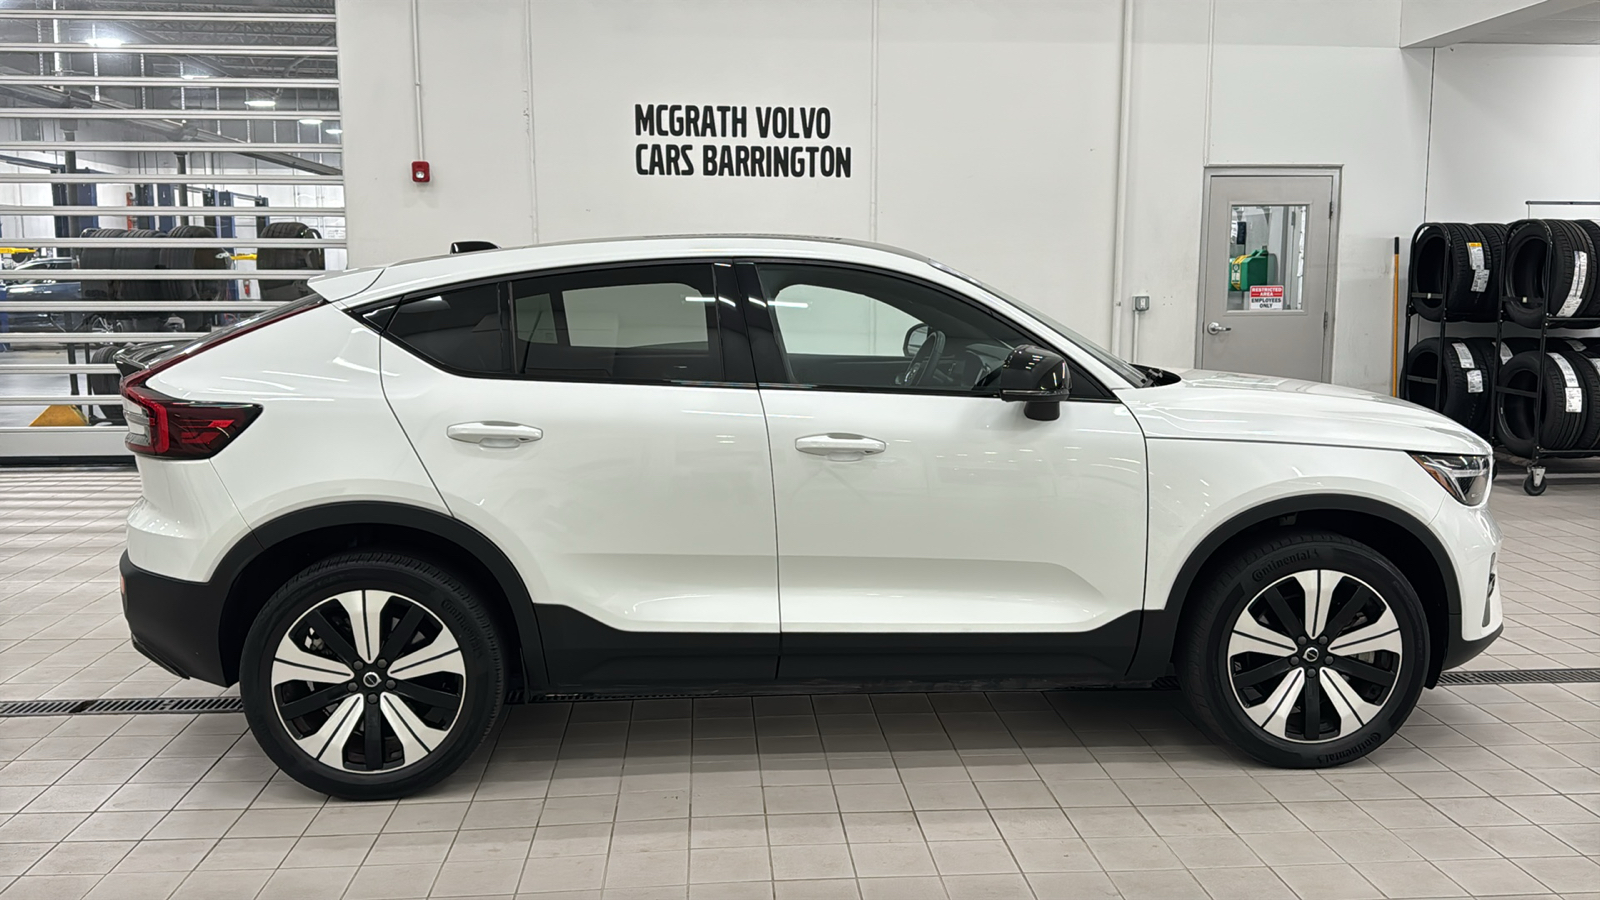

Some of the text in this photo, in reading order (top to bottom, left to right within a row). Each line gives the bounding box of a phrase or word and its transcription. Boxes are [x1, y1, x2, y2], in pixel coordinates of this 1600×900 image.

[635, 104, 831, 138] MCGRATH VOLVO
[636, 144, 851, 177] CARS BARRINGTON
[1252, 550, 1310, 582] Continental
[1326, 732, 1381, 763] Continental
